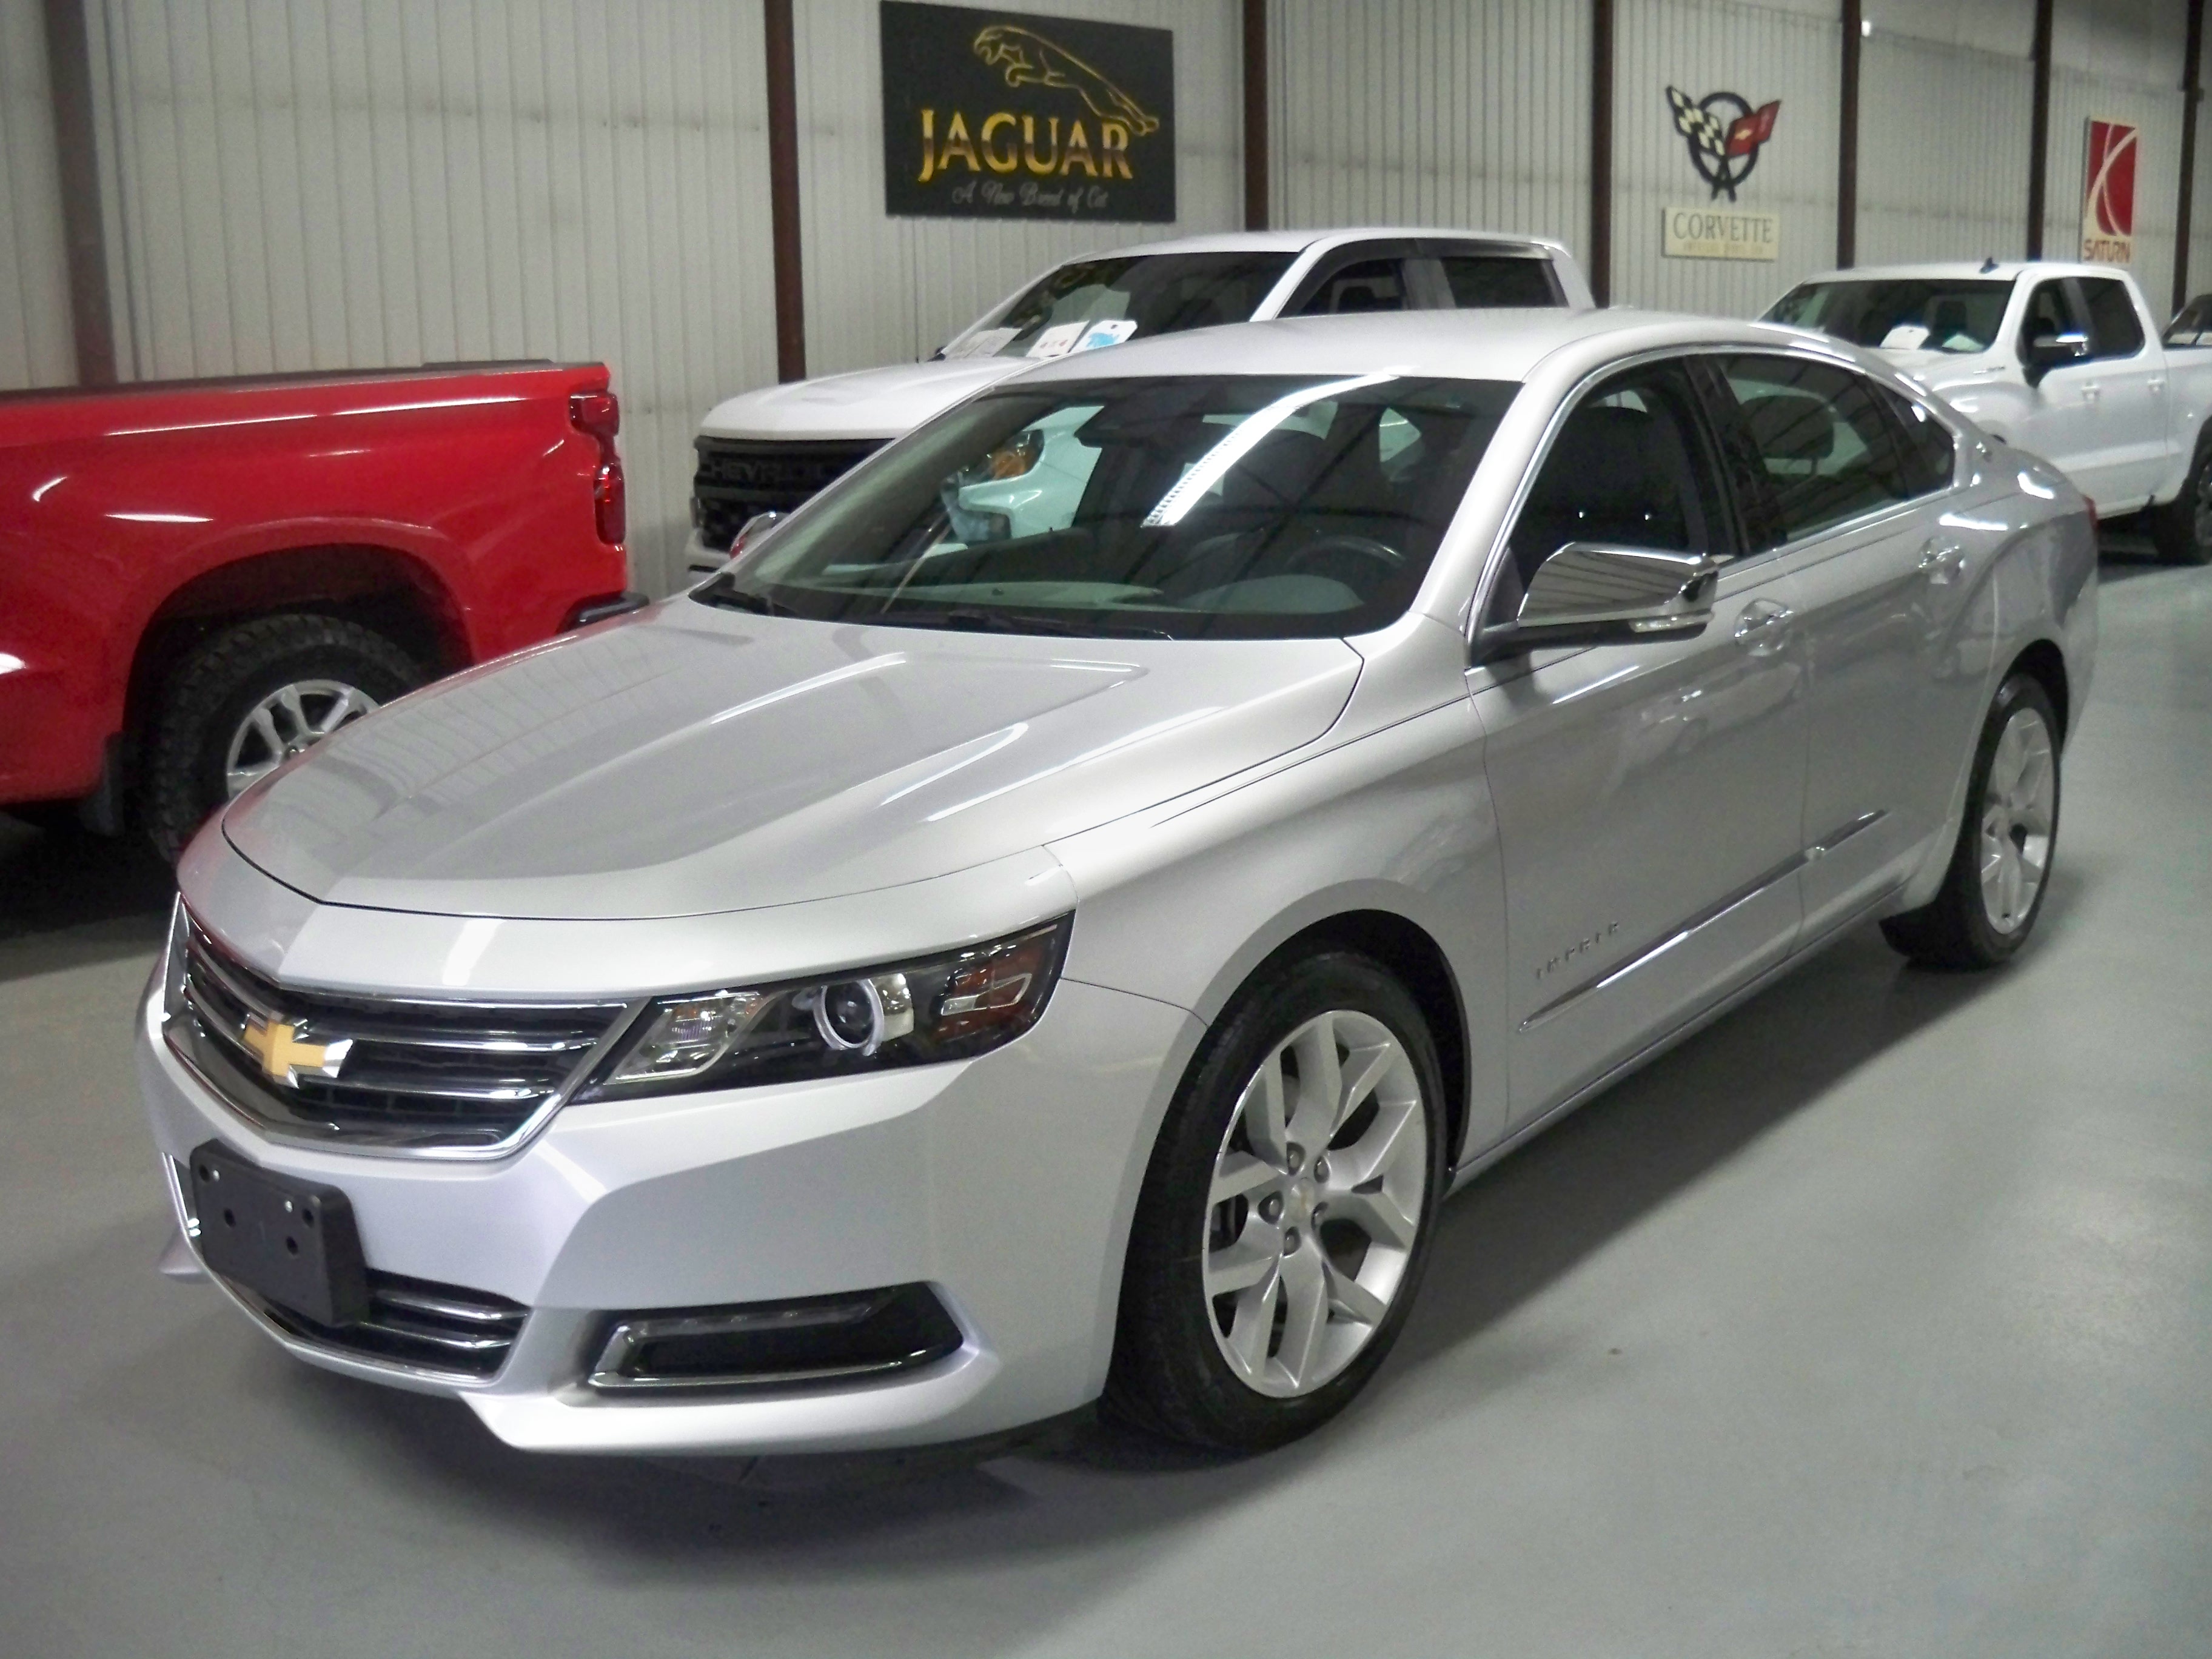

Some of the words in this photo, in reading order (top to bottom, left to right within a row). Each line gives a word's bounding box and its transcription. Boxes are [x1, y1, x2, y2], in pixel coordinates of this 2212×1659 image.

[918, 109, 1133, 182] JAGUAR
[1673, 213, 1774, 243] CORVETTE
[2083, 238, 2130, 263] SATURN
